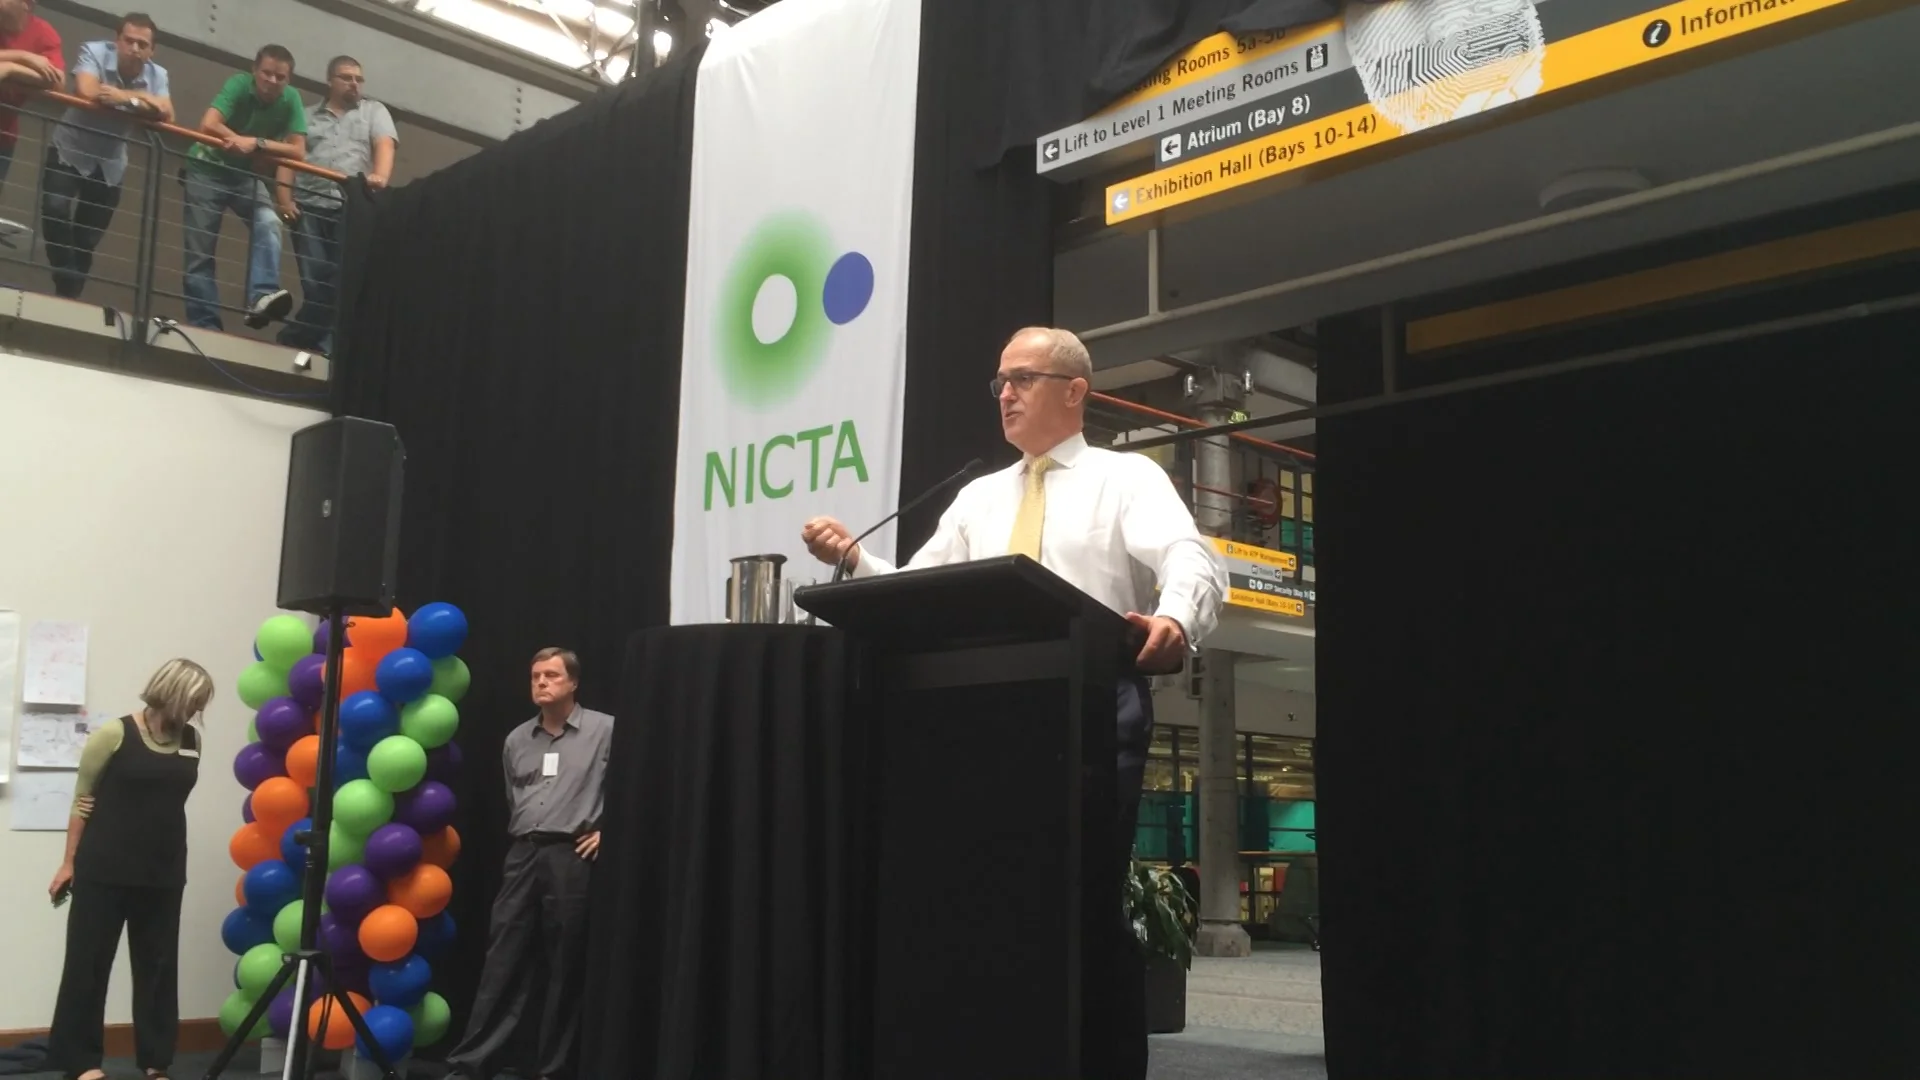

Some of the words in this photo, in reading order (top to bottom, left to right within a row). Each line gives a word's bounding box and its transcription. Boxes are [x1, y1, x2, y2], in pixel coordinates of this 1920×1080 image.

[1064, 132, 1088, 153] Lift
[1094, 129, 1107, 143] to
[1113, 110, 1150, 136] Level
[1157, 104, 1165, 121] 1
[1172, 83, 1236, 116] Meeting
[1242, 61, 1299, 92] Rooms
[1177, 47, 1230, 76] Rooms
[1136, 169, 1213, 204] Exhibition
[1219, 153, 1252, 178] Hall
[1258, 140, 1306, 168] (Bays
[1313, 113, 1377, 149] 10-14)
[1187, 120, 1242, 150] Atrium
[1247, 105, 1286, 132] (Bay
[1291, 94, 1311, 116] 8)
[704, 419, 869, 511] NICTA
